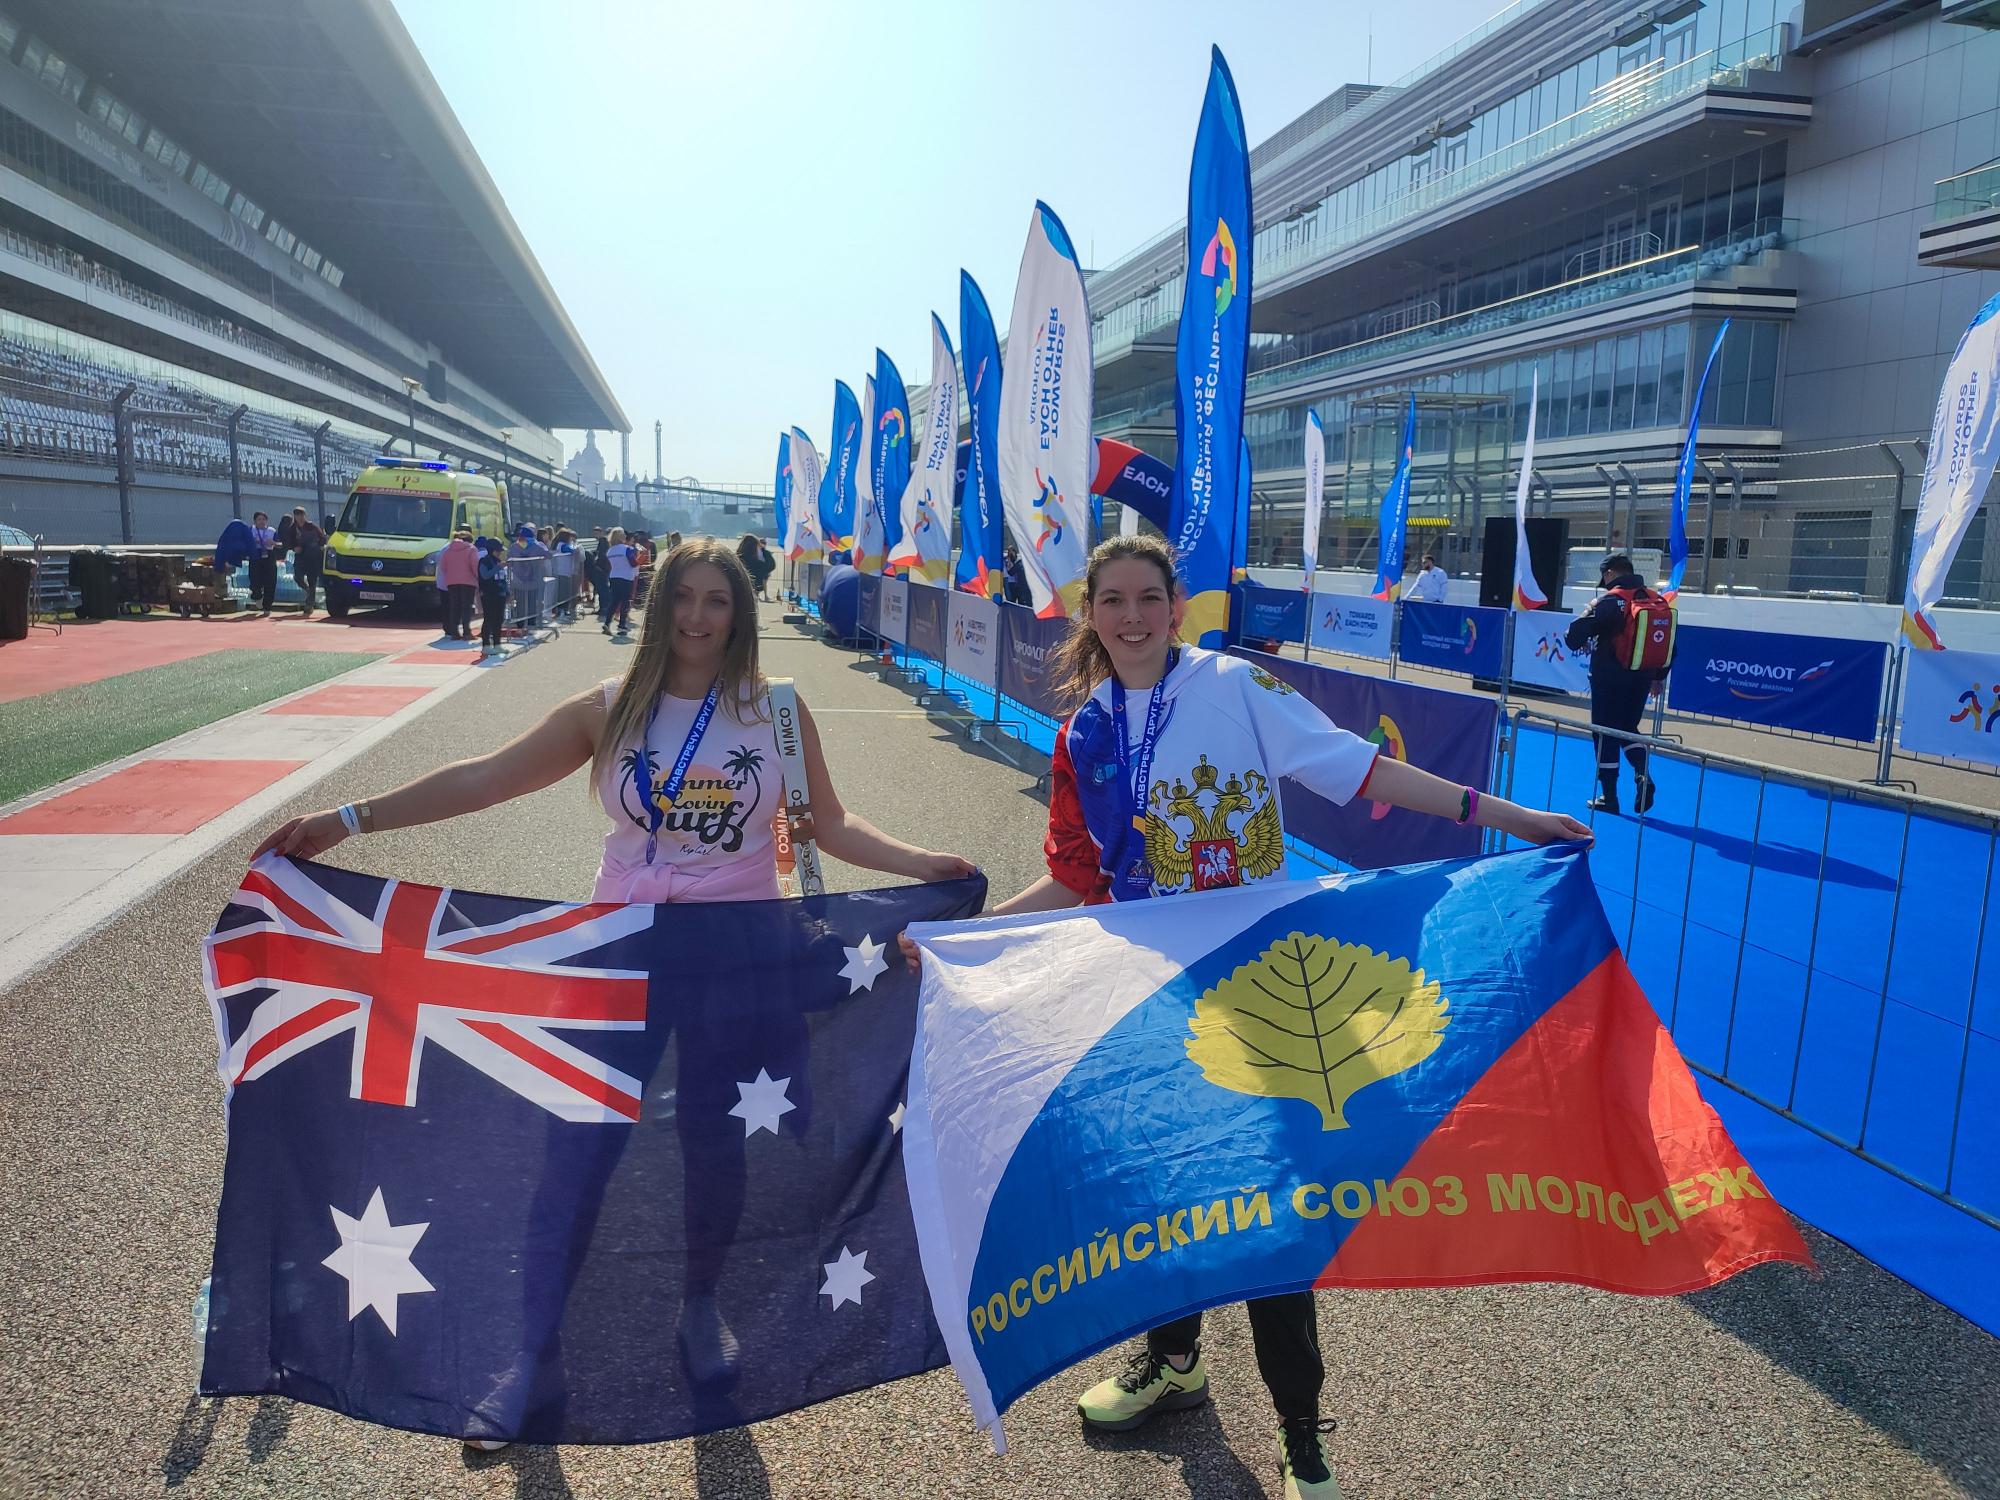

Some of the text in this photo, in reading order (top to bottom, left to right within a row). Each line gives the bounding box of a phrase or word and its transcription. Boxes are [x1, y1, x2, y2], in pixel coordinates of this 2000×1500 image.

[1948, 383, 1968, 487] TOWARDS
[1963, 371, 1978, 439] OTHER
[394, 475, 420, 483] 103
[1122, 465, 1171, 498] EACH
[1705, 658, 1796, 680] АЭРОФЛОТ
[667, 731, 700, 792] НАВСТРЕЧУ
[696, 706, 714, 732] ДРУГ
[1136, 680, 1163, 810] НАВСТРЕЧУ ДРУГ ДРУ
[970, 1166, 1767, 1345] РОССИЙСКИЙ СОЮЗ МОЛОДЕЖ
